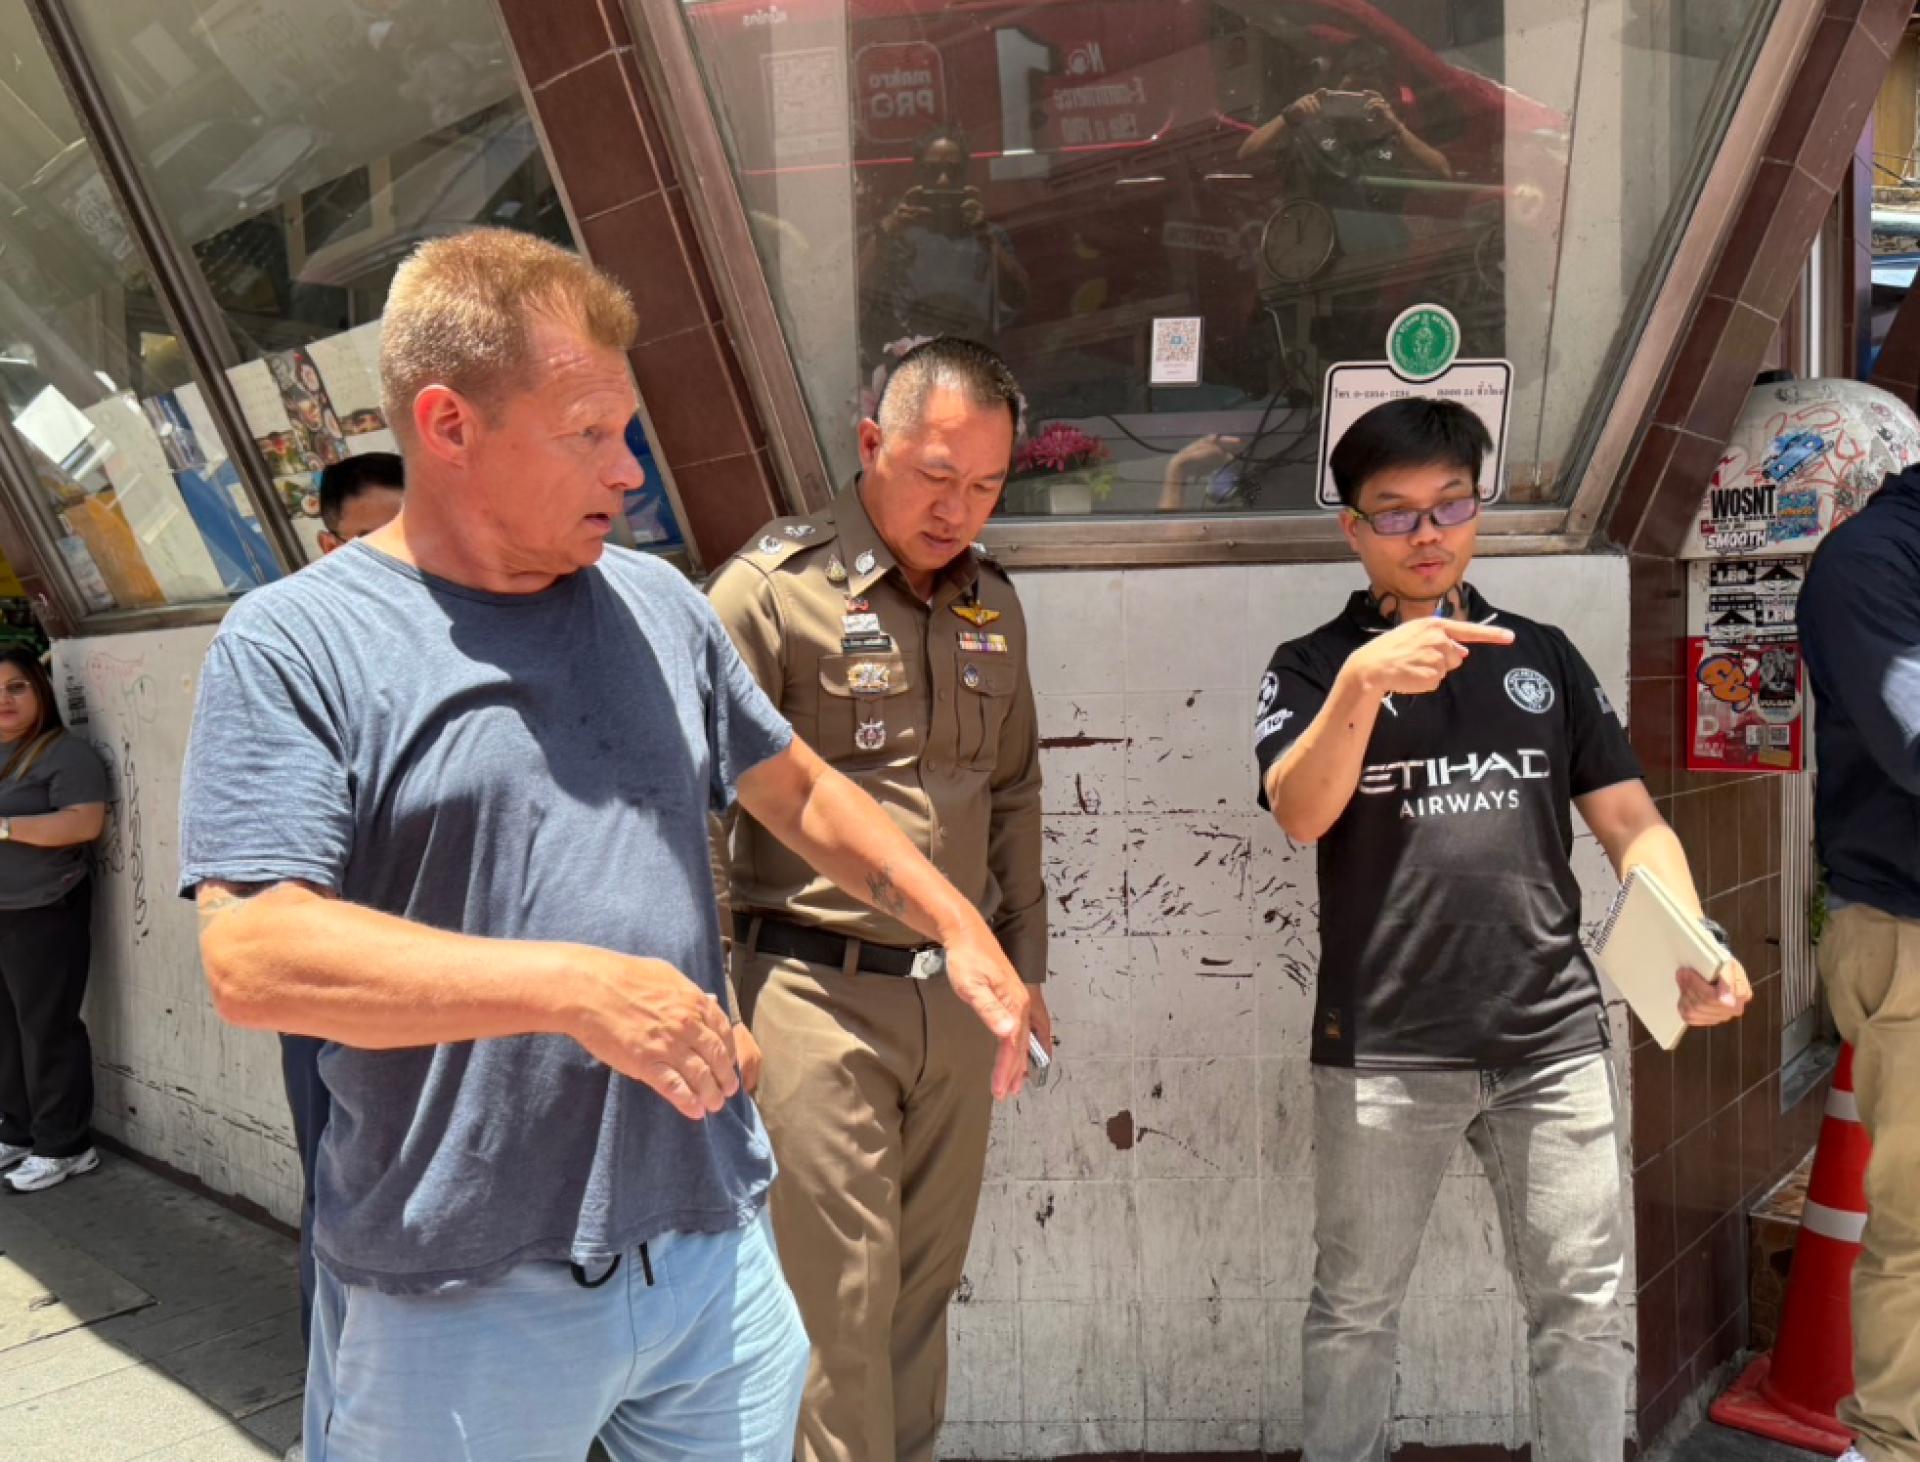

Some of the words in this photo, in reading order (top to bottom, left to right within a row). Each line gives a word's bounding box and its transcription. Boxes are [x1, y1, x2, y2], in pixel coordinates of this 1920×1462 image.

[1711, 485, 1776, 517] WOSNT
[1360, 749, 1551, 794] ETIHAD
[1400, 789, 1520, 818] AIRWAYS
